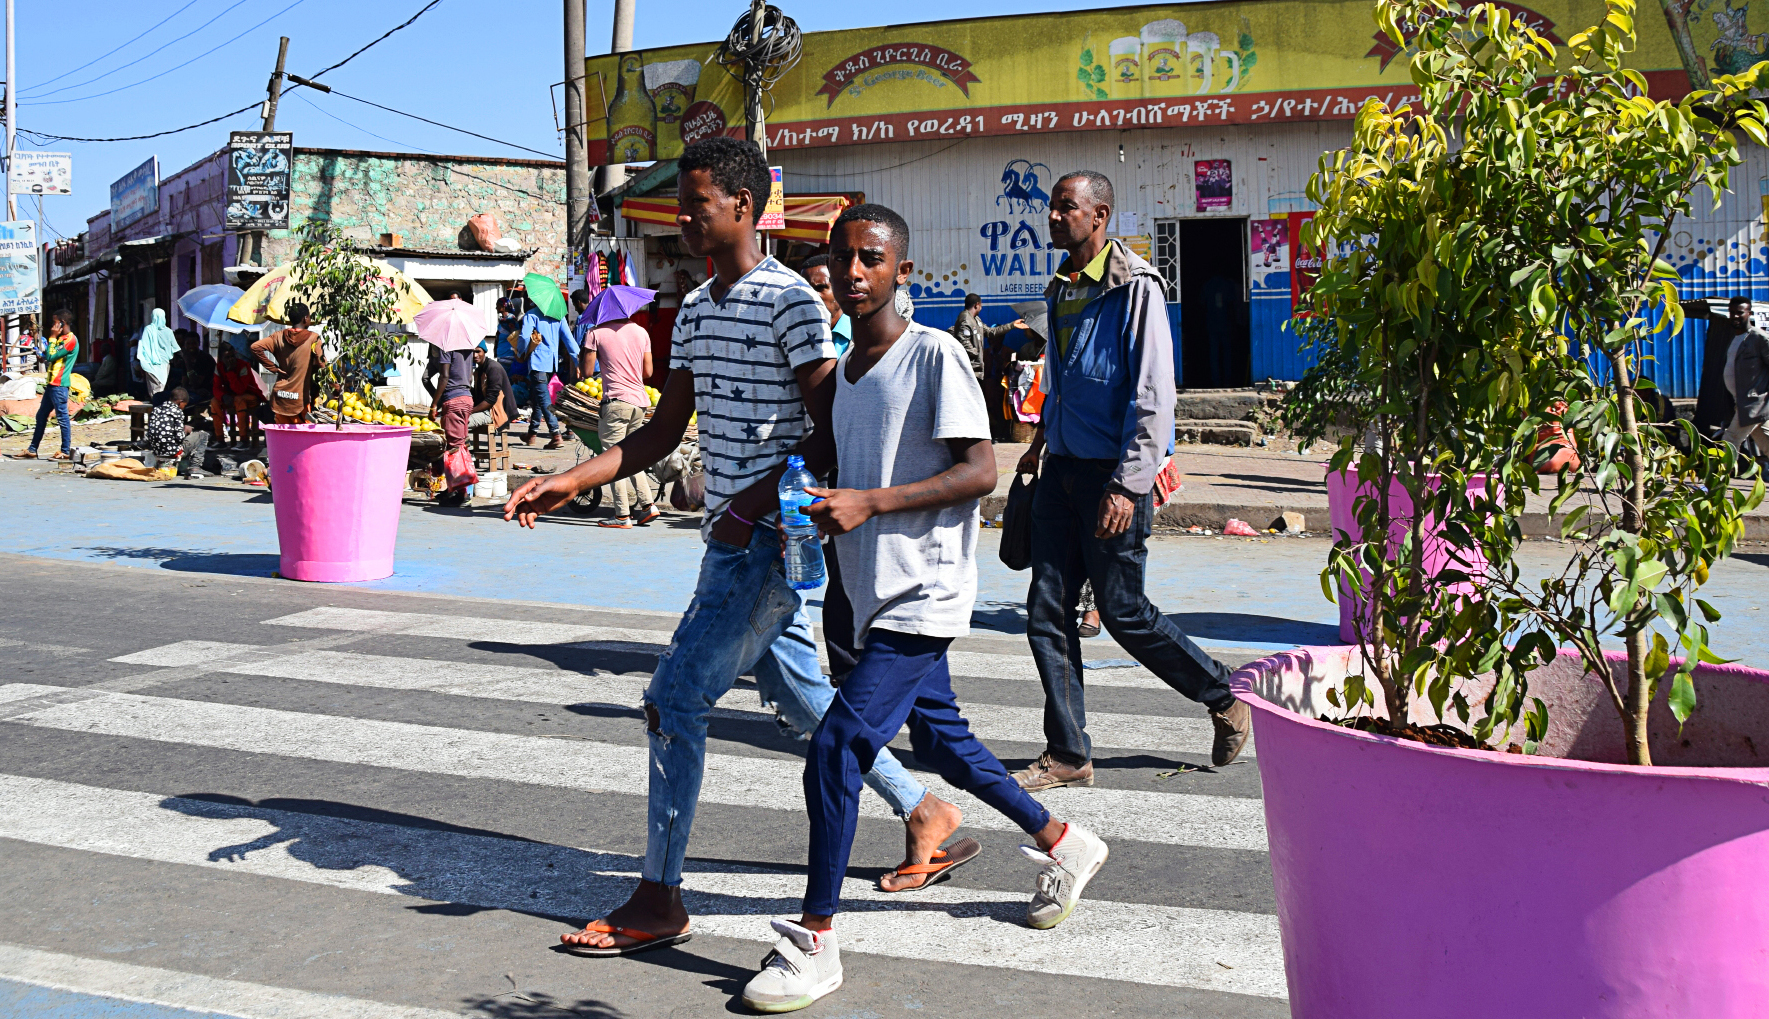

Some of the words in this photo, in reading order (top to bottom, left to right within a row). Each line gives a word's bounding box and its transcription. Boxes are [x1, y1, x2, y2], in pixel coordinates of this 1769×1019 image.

[834, 56, 869, 82] ቅዱስ
[873, 47, 931, 64] ጊዮርጊስ
[936, 52, 963, 71] ቢራ
[915, 68, 947, 88] Beer
[852, 121, 894, 141] ክ/ከ
[1001, 111, 1059, 131] ሚዛን
[980, 219, 1055, 253] ዋል
[1000, 283, 1023, 293] LAGER
[1024, 283, 1043, 293] BEER
